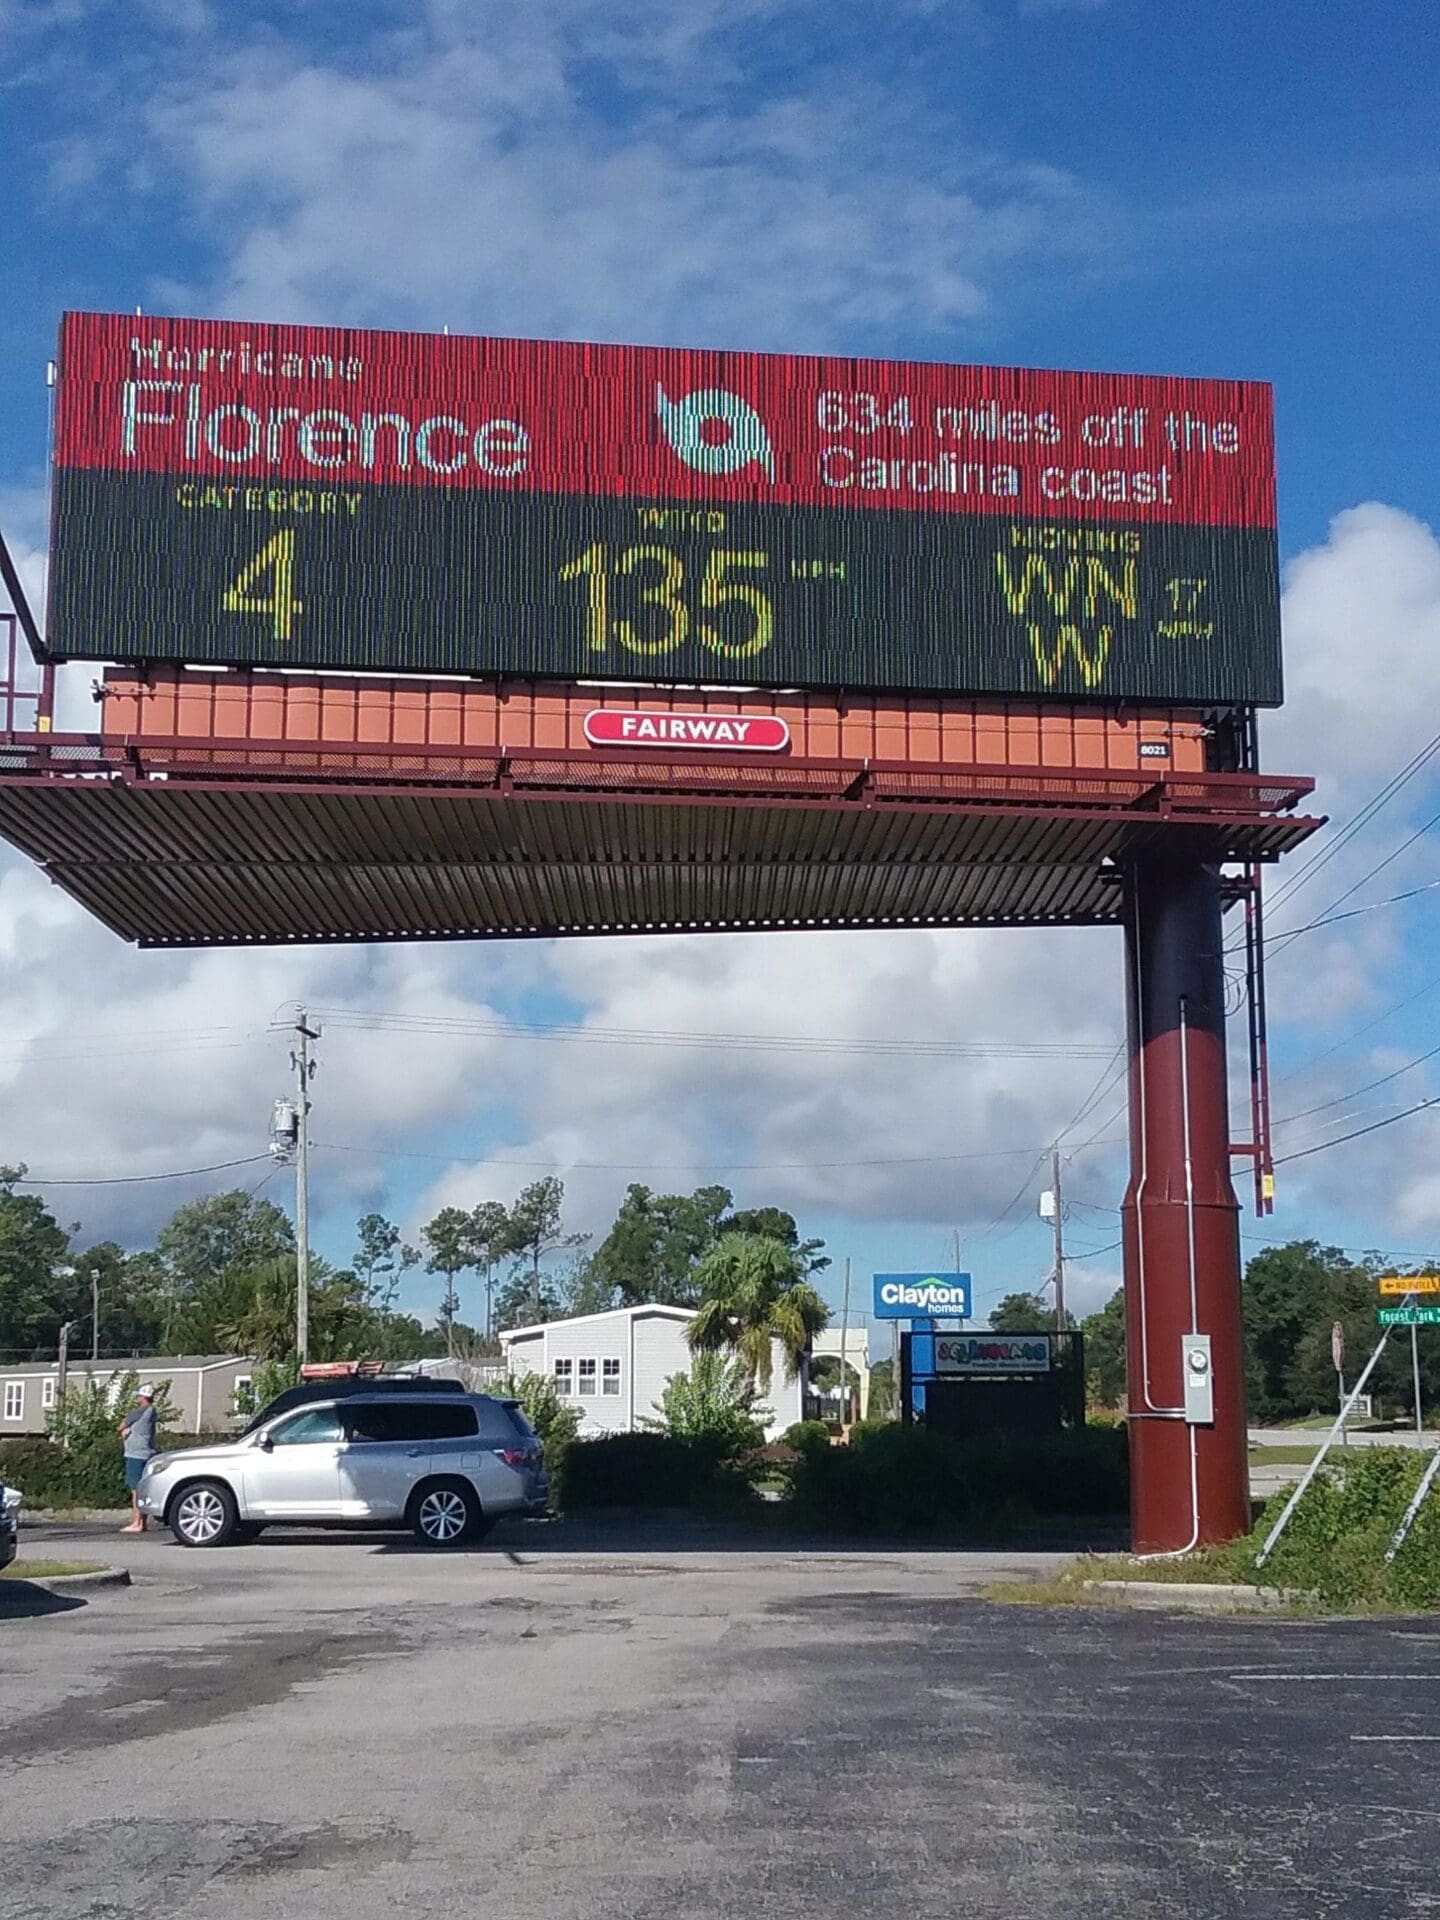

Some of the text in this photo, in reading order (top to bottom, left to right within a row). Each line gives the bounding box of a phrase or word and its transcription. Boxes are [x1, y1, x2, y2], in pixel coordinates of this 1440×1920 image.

[131, 337, 362, 380] Hurricane
[122, 378, 531, 476] Florence
[818, 390, 1239, 454] 634 miles off the
[818, 445, 1172, 505] Carolina coast
[177, 484, 362, 515] CATEGORY
[1011, 525, 1140, 553] MOVING
[223, 526, 303, 640] 4
[559, 542, 773, 659] 135
[622, 716, 750, 742] FAIRWAY
[1140, 745, 1166, 755] 8021
[881, 1283, 964, 1308] Clayton
[928, 1303, 964, 1313] homes
